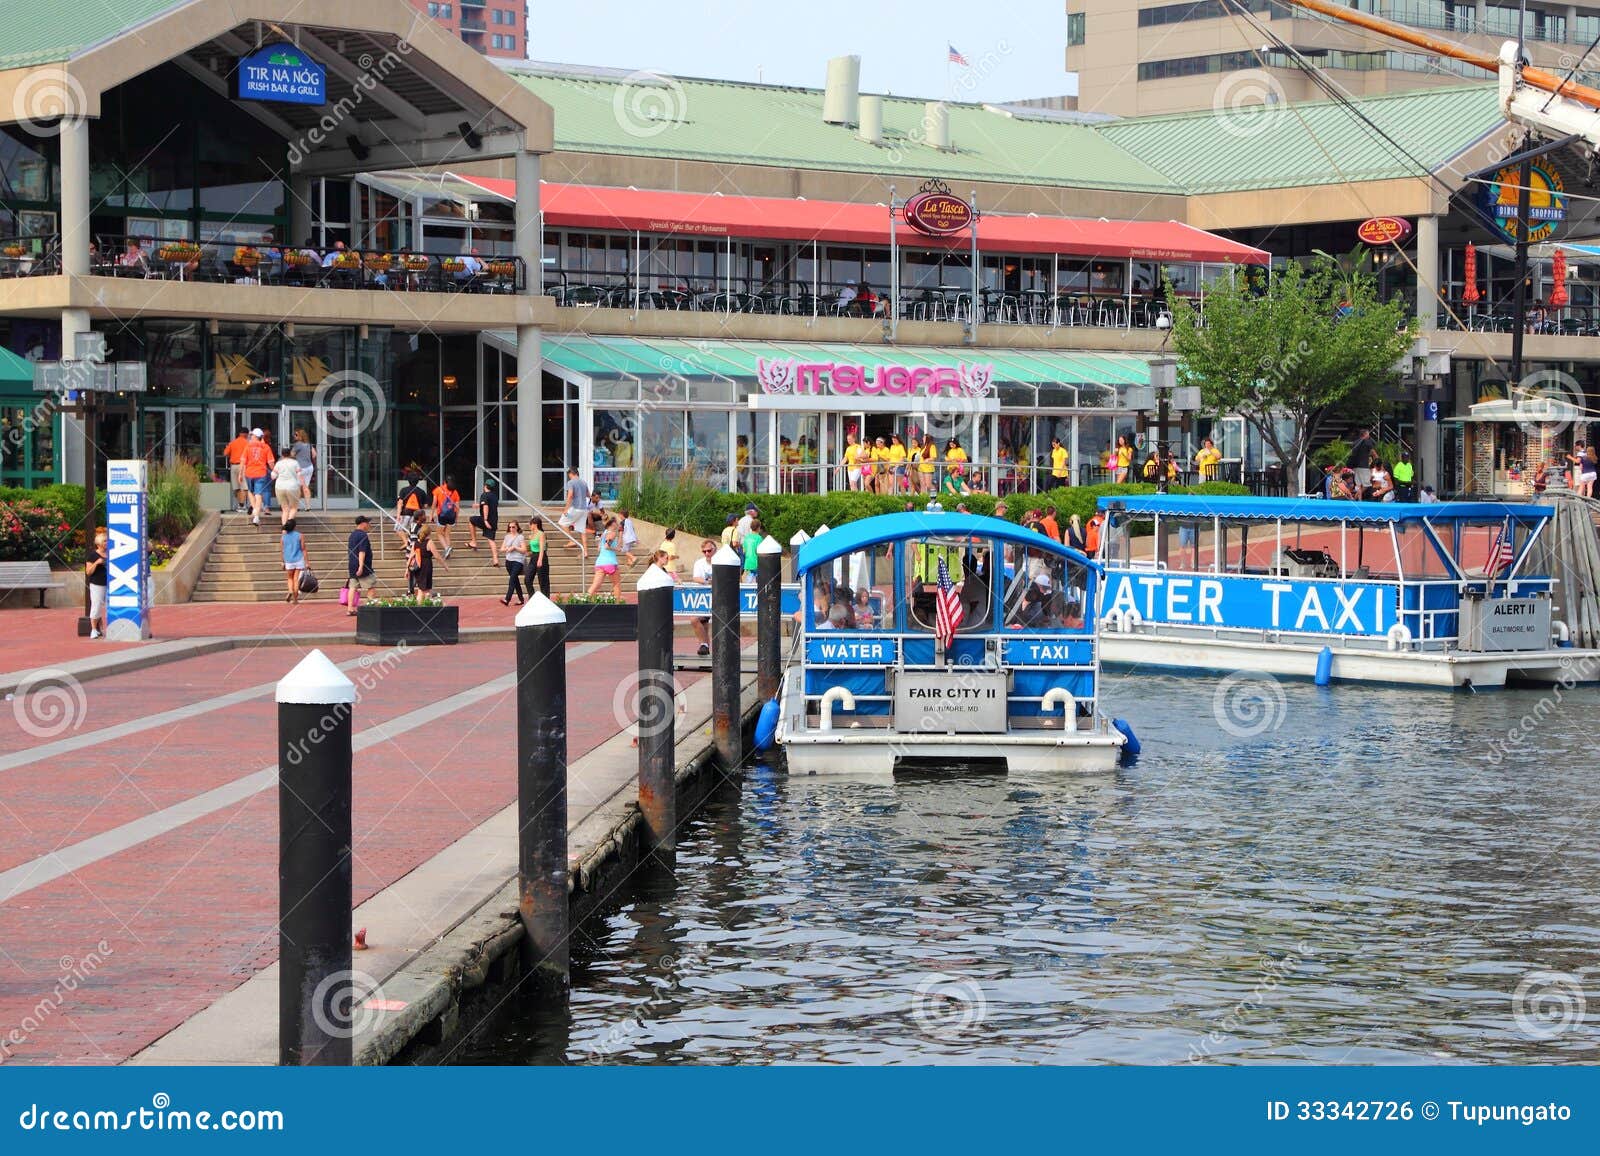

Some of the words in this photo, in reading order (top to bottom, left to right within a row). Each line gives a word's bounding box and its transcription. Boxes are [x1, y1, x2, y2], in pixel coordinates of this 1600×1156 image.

[247, 66, 269, 81] TIR
[272, 69, 290, 83] NA
[247, 81, 270, 92] IRISH
[271, 83, 289, 93] BAR
[290, 85, 297, 94] &
[297, 86, 320, 96] GRILL
[923, 200, 938, 212] La
[939, 201, 965, 214] Tasca
[1499, 206, 1519, 216] DININ
[1531, 208, 1563, 219] SHOPPING
[108, 493, 139, 505] WATER
[108, 504, 139, 608] TAXI
[1262, 582, 1384, 633] TAXI
[1494, 604, 1527, 616] ALERT
[1528, 604, 1536, 615] II
[1492, 625, 1526, 634] BALTIMORE,
[1526, 625, 1536, 633] MD
[821, 644, 883, 659] WATER
[1030, 645, 1069, 660] TAXI
[909, 688, 942, 699] FAIR
[946, 688, 981, 699] CITY
[986, 688, 996, 699] II
[967, 705, 979, 713] MD
